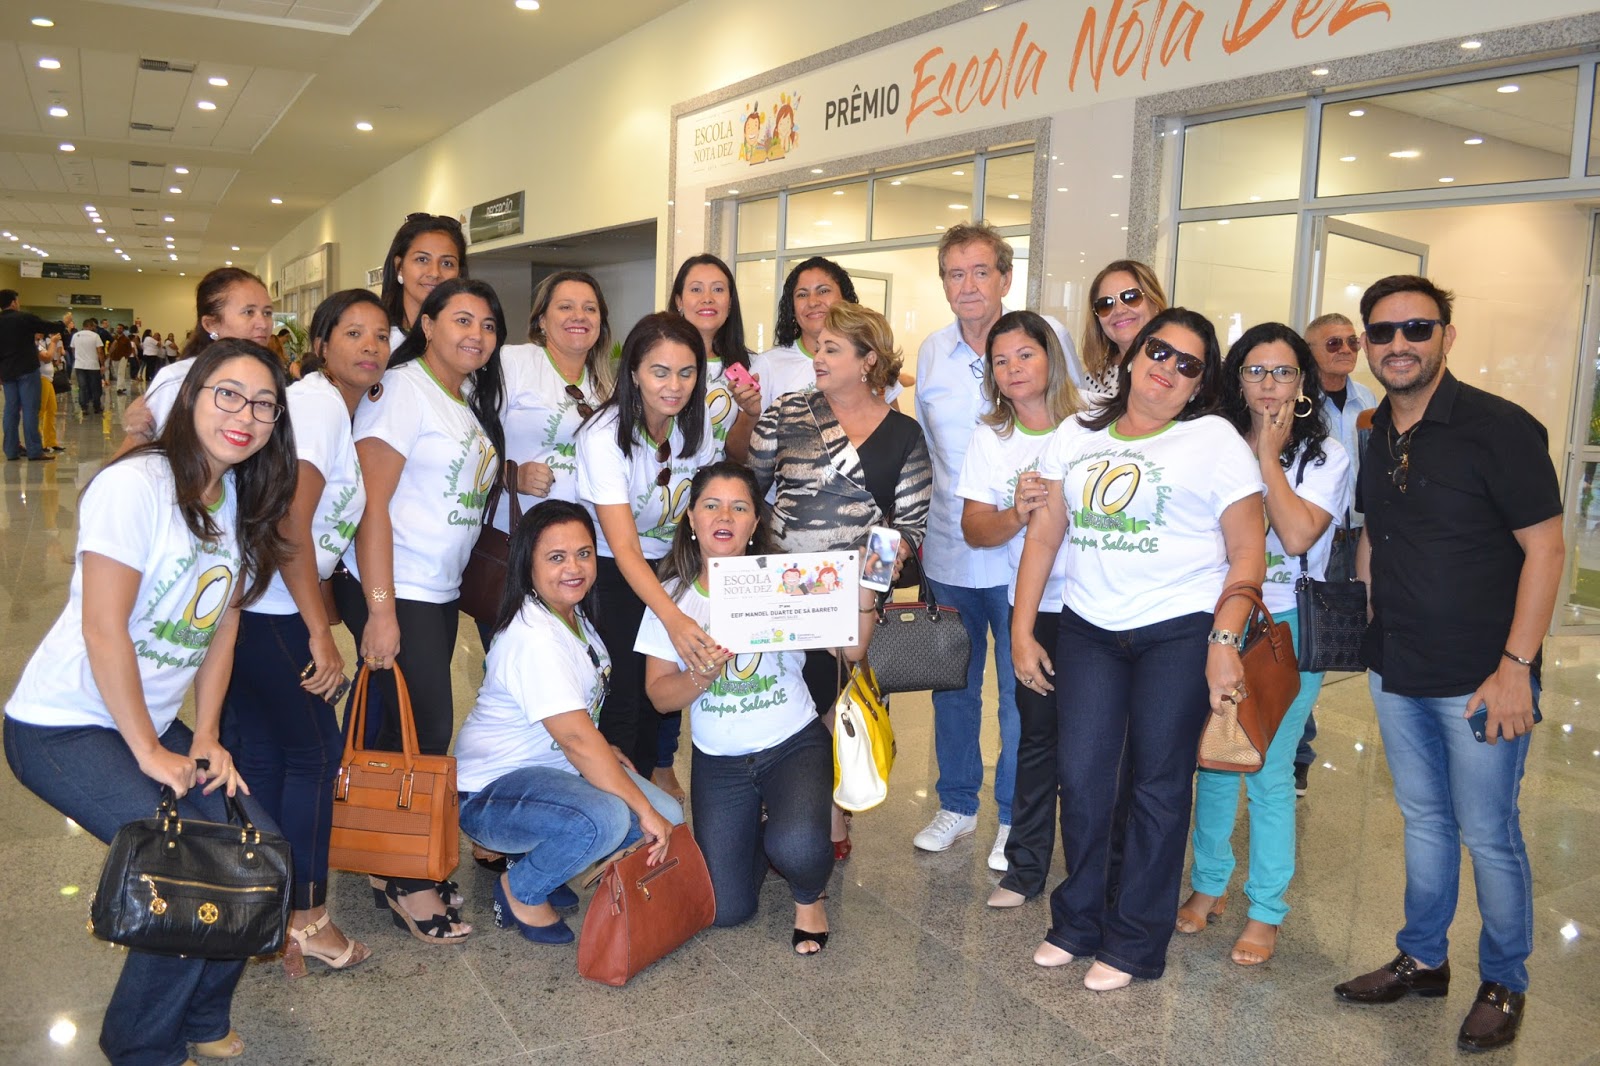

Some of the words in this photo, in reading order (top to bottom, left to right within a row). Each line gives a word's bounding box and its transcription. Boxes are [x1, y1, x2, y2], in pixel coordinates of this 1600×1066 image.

[825, 84, 900, 131] PRÊMIO
[906, 22, 1047, 135] Escola
[1069, 0, 1204, 94] Nota
[695, 120, 733, 146] ESCOLA
[694, 147, 715, 163] NOTA
[718, 142, 733, 158] DEZ
[1082, 460, 1141, 515] 10
[723, 586, 752, 596] NOTA
[753, 584, 773, 594] DEZ
[724, 574, 771, 586] ESCOLA
[770, 609, 793, 617] DUARTE
